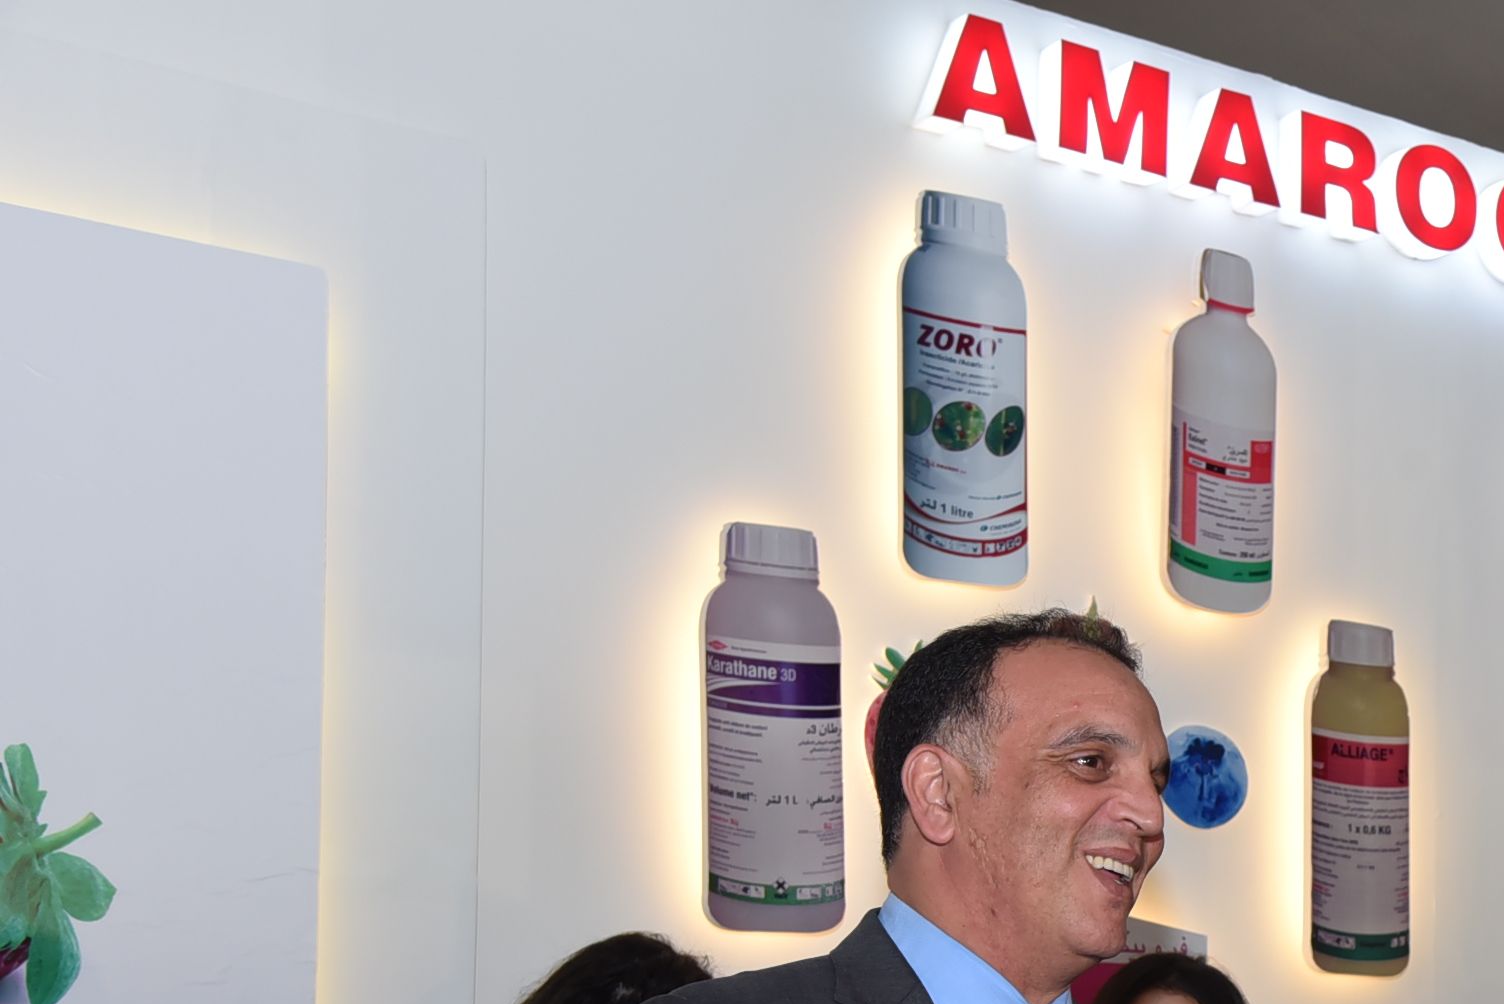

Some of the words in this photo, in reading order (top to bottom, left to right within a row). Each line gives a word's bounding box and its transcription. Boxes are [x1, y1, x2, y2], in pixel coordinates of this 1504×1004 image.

[951, 505, 974, 519] litre
[707, 655, 777, 681] Karathane
[780, 668, 797, 682] 3D
[1378, 825, 1392, 836] KG
